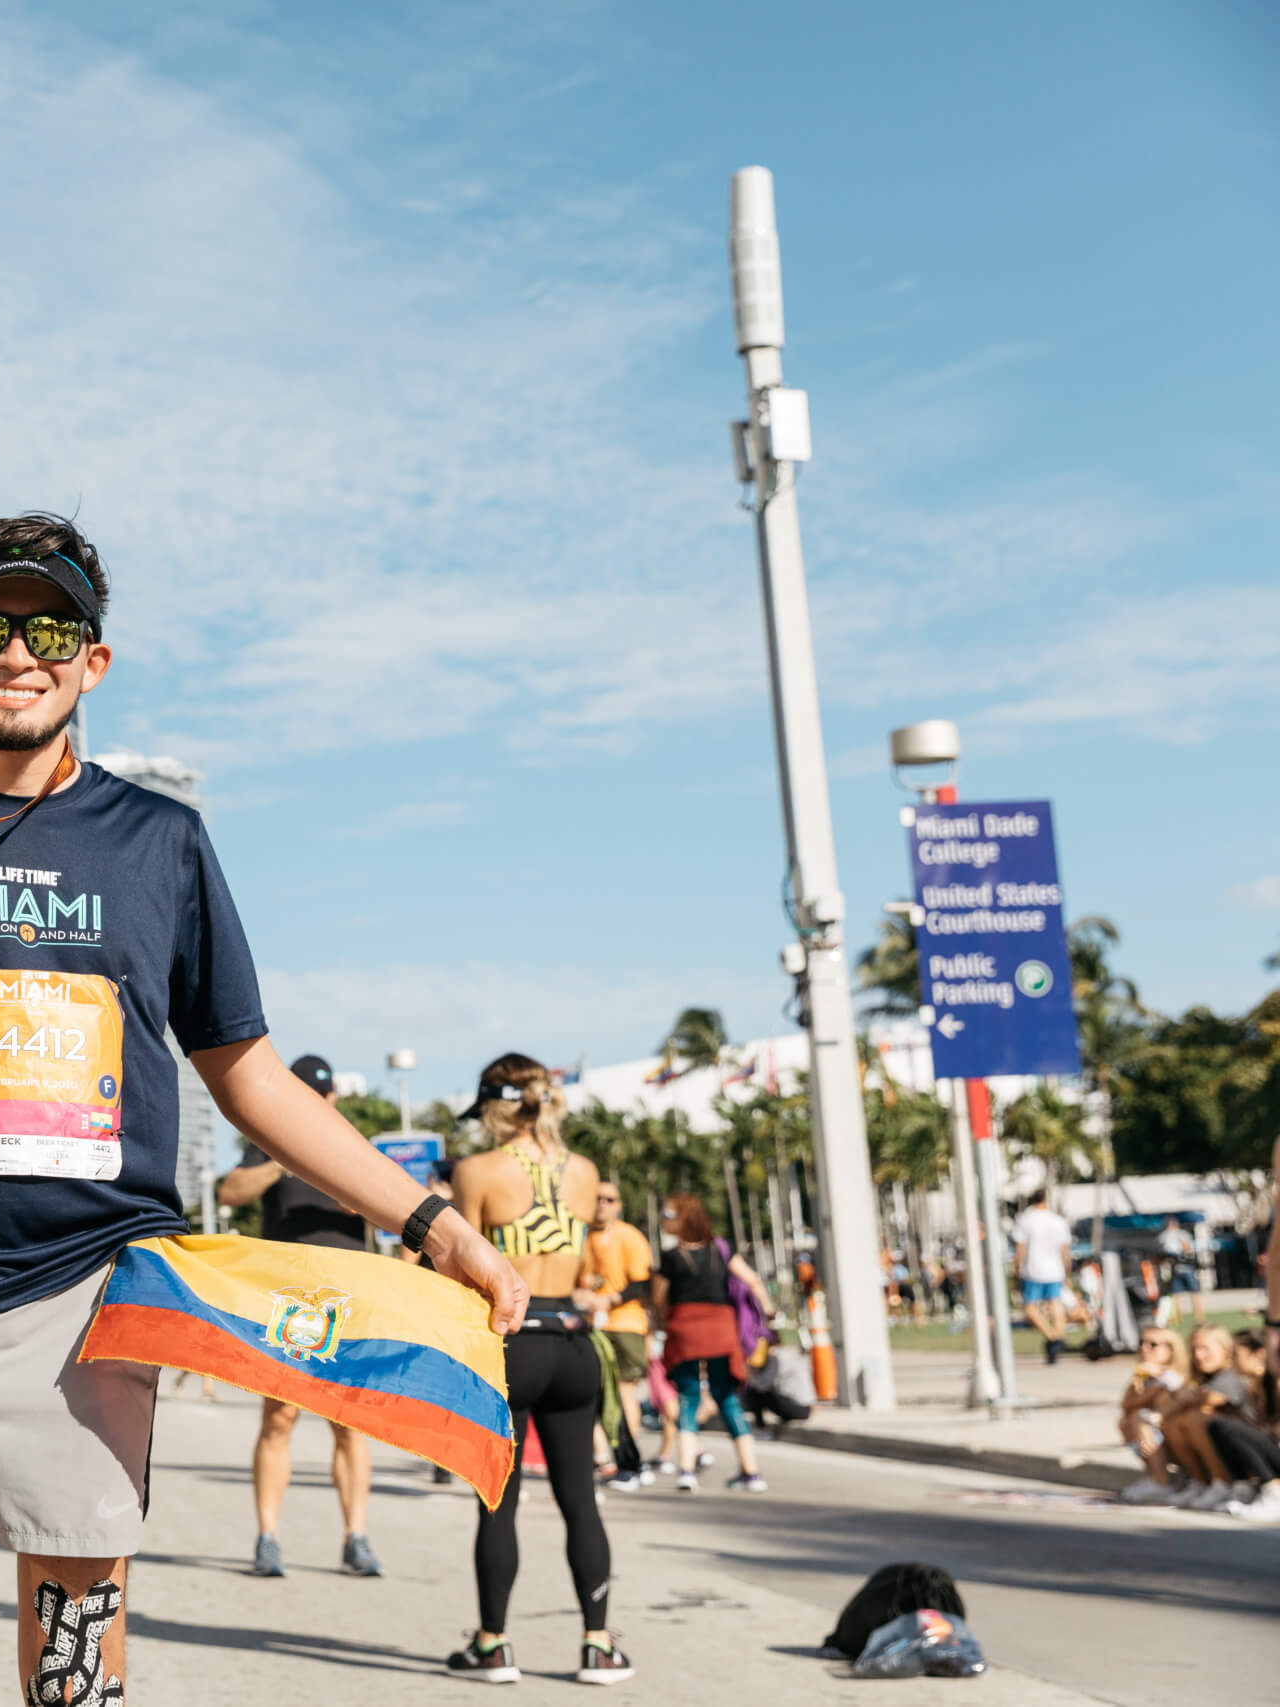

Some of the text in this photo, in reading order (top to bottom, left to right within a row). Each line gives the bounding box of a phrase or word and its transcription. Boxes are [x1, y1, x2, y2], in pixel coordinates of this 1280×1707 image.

[916, 813, 1039, 839] Miami Dade
[919, 842, 1000, 867] College
[923, 883, 1062, 908] United States
[926, 910, 1046, 934] Courthouse
[39, 930, 66, 940] AND
[69, 931, 102, 941] HALF
[929, 953, 996, 979] Public
[0, 979, 71, 1006] MIAMI
[932, 980, 1014, 1008] Parking
[104, 1079, 112, 1093] F
[81, 1595, 104, 1613] TAPE
